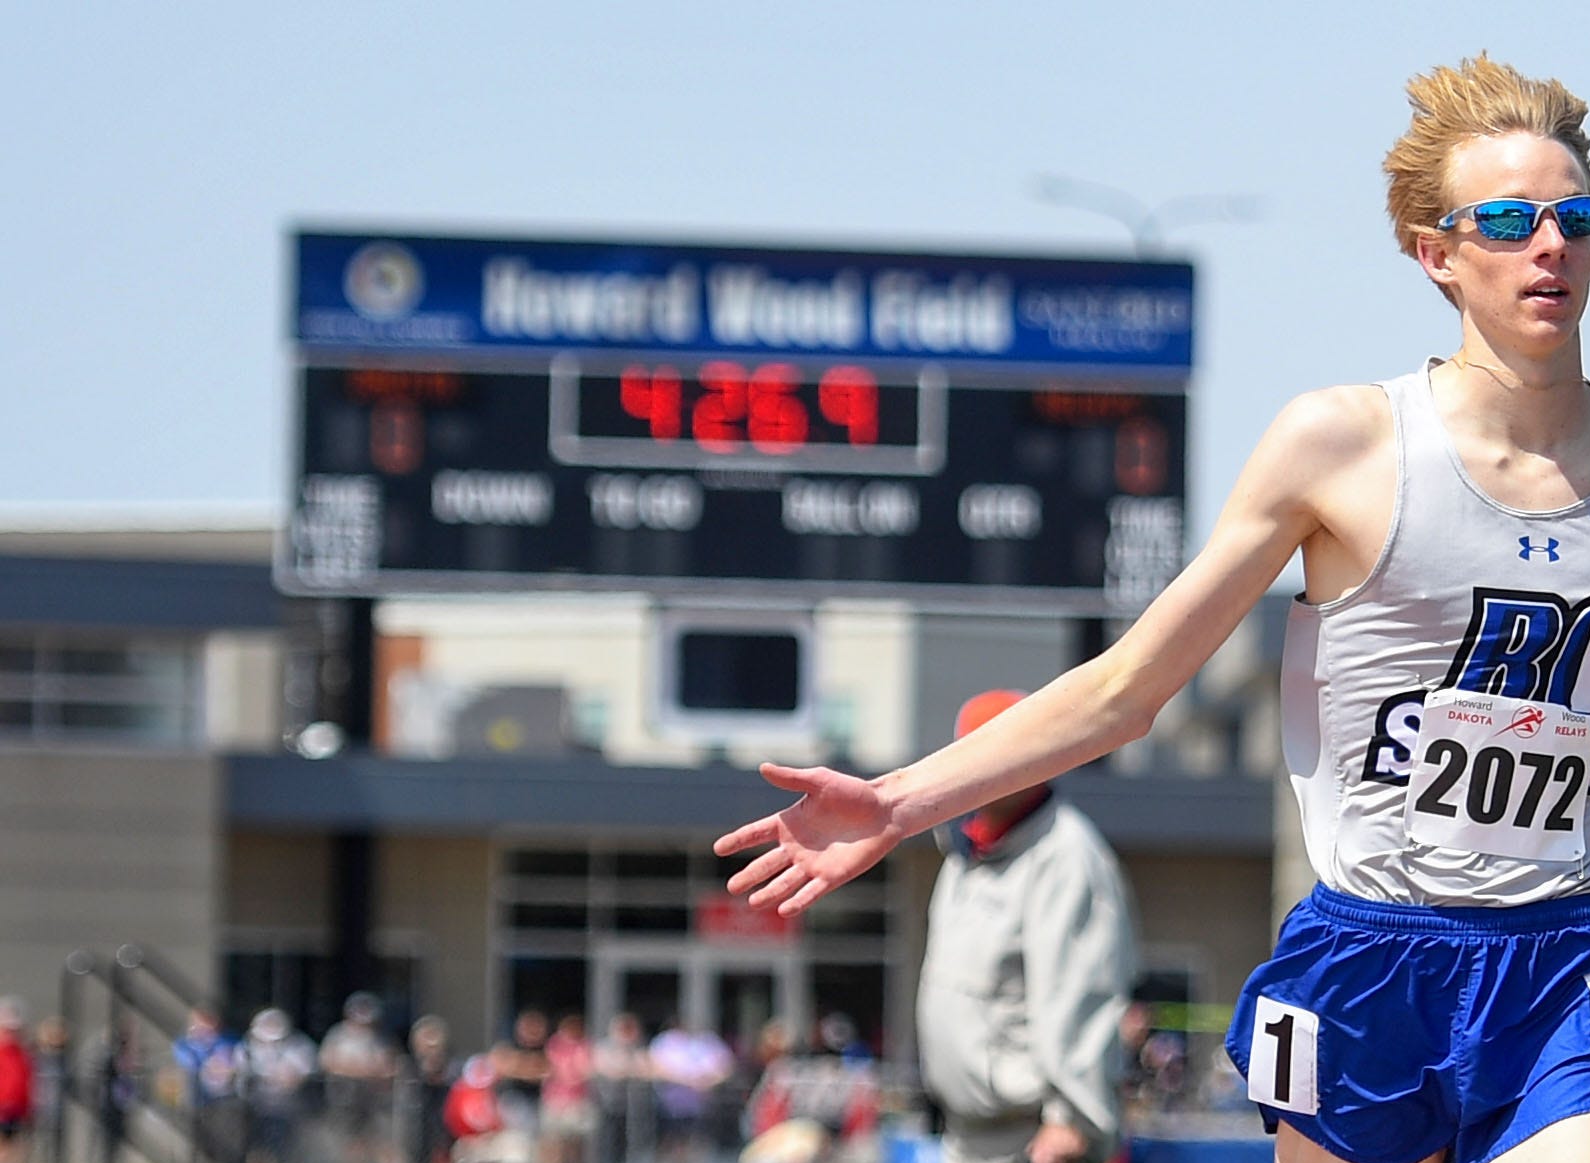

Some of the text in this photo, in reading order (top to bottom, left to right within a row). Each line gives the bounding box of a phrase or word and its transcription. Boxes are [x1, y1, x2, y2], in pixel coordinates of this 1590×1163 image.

[1447, 710, 1587, 737] DAKOTA RELAYS
[1454, 697, 1493, 711] Howard
[1415, 738, 1586, 832] 2072
[1264, 1013, 1294, 1103] 1
